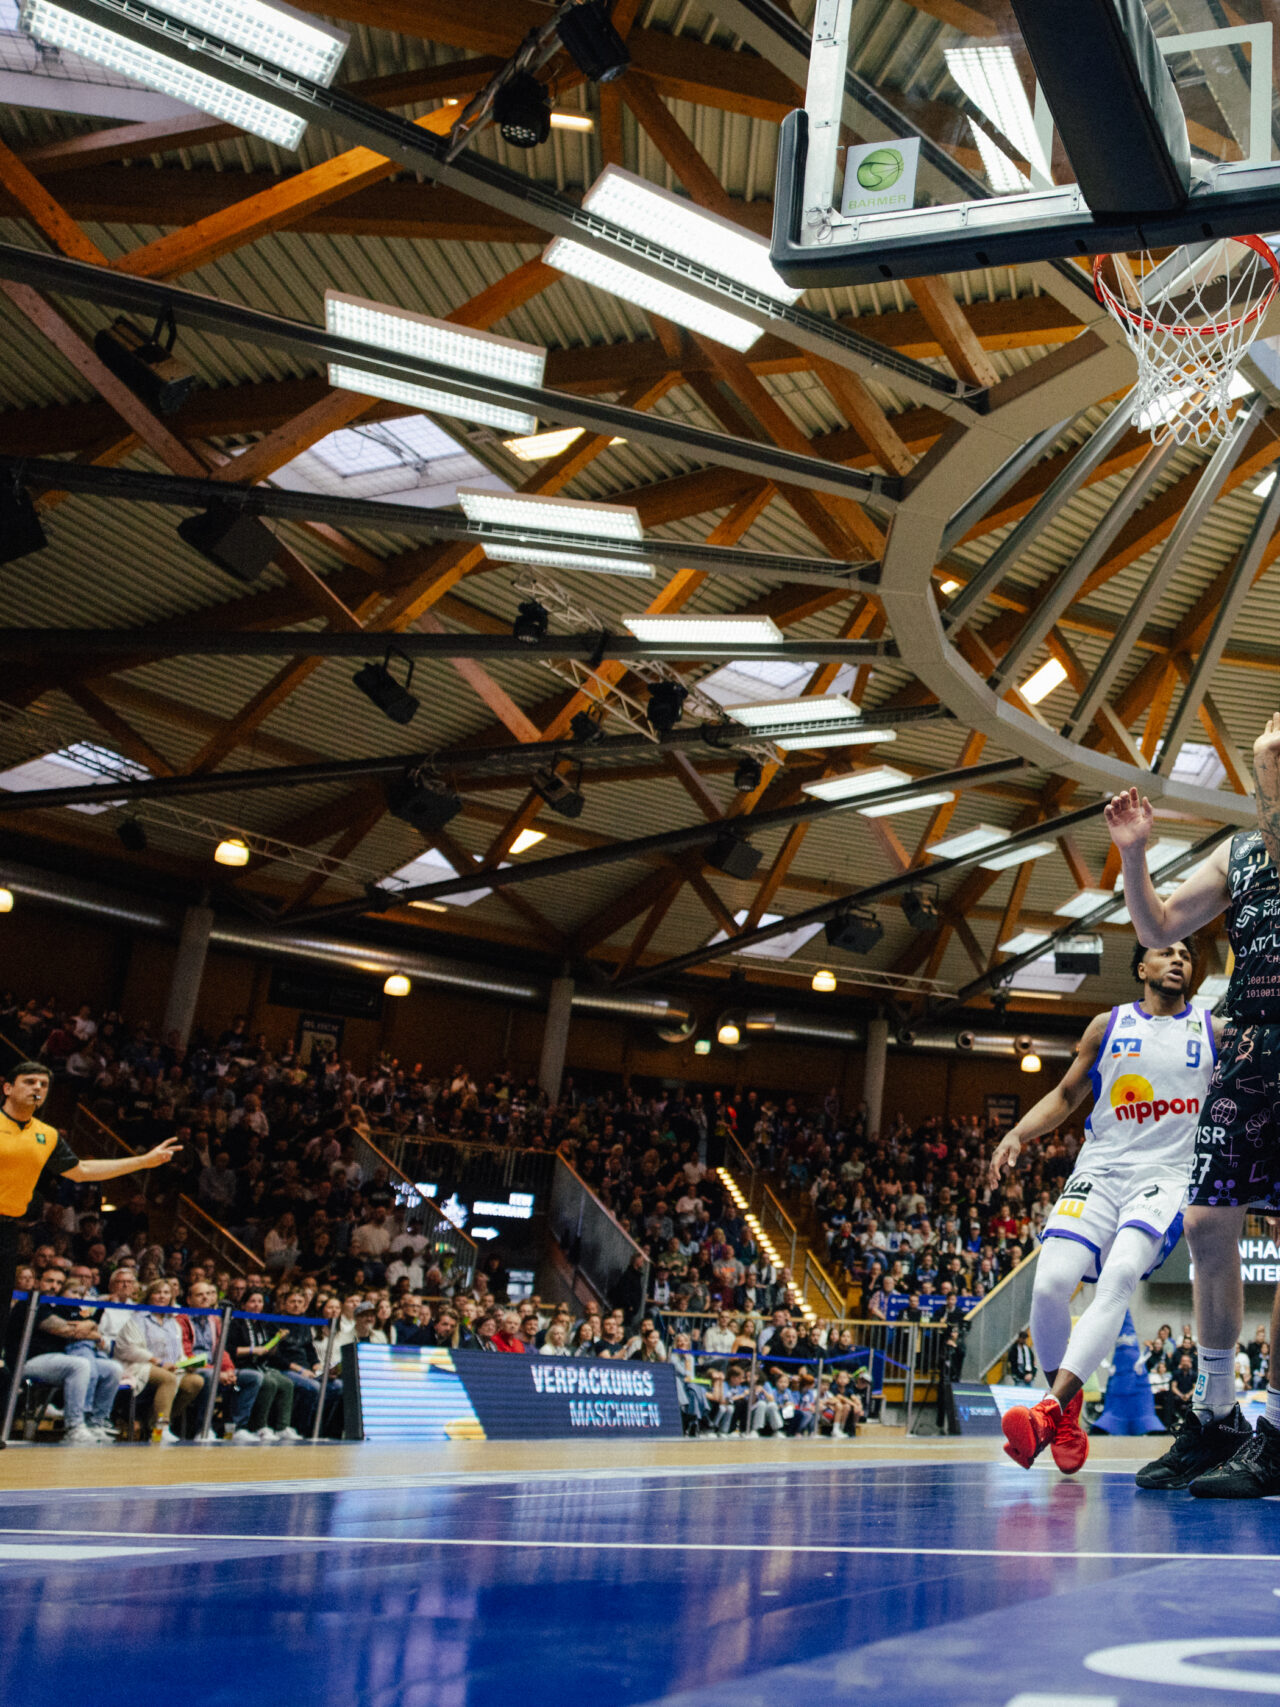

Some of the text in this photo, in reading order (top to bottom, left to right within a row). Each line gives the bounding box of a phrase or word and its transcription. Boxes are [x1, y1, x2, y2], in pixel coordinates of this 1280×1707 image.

[848, 194, 906, 210] BARMER
[1232, 865, 1256, 899] 27
[1186, 1039, 1201, 1069] 9
[1115, 1098, 1199, 1124] nippon
[530, 1364, 655, 1397] VERPACKUNGS
[568, 1400, 661, 1427] MASCHINEN
